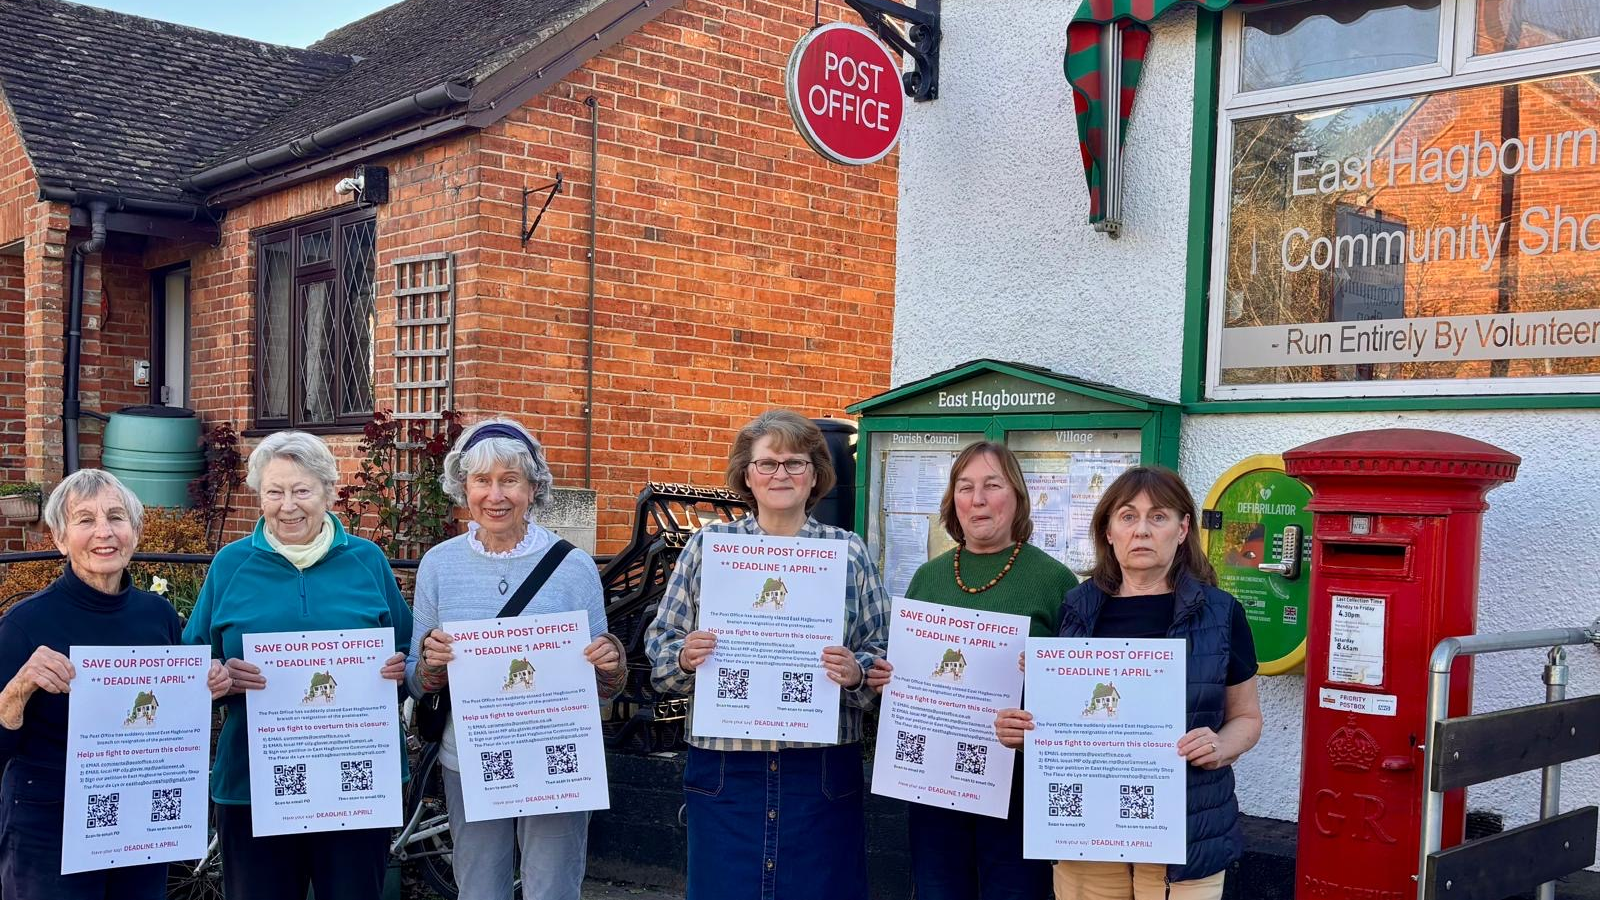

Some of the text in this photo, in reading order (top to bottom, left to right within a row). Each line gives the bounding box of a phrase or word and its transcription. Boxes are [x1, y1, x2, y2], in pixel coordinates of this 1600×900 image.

[825, 51, 884, 94] POST
[808, 84, 890, 132] OFFICE
[1293, 127, 1599, 196] East Hagbourn
[1282, 213, 1506, 272] Community
[1286, 328, 1332, 355] Run
[1340, 321, 1427, 358] Entirely
[1435, 320, 1467, 356] By
[1475, 317, 1600, 347] Volunteer
[938, 389, 1056, 411] East Hagbourne
[892, 433, 960, 444] Parish Council
[1055, 432, 1094, 445] Village
[1237, 502, 1296, 516] DEFIBRILLATOR
[713, 544, 836, 559] SAVE OUR POST OFFICE!
[732, 561, 816, 573] DEADLINE 1 APRIL
[1338, 610, 1361, 619] 4.30pm
[900, 609, 1018, 635] SAVE OUR POST OFFICE!
[454, 622, 578, 641] SAVE OUR POST OFFICE!
[708, 627, 724, 635] Help
[915, 629, 960, 643] DEADLINE
[969, 638, 996, 648] APRIL
[254, 639, 383, 652] SAVE OUR POST OFFICE!
[475, 644, 522, 655] DEADLINE
[532, 641, 560, 650] APRIL
[1036, 649, 1173, 660] SAVE OUR POST OFFICE!
[82, 657, 202, 668] SAVE OUR POST OFFICE!
[276, 658, 326, 667] DEADLINE
[336, 656, 364, 665] APRIL
[1058, 667, 1151, 676] DEADLINE 1 APRIL
[103, 676, 151, 685] DEADLINE
[160, 675, 185, 683] APRIL
[890, 690, 904, 698] Help
[914, 695, 929, 703] fight
[938, 700, 966, 708] overturn
[1340, 694, 1366, 703] PRIORITY
[1340, 702, 1366, 710] POSTBOX
[1064, 739, 1081, 747] fight
[525, 794, 555, 802] DEADLINE
[928, 786, 956, 796] DEADLINE
[961, 792, 980, 800] APRIL!
[316, 810, 347, 818] DEADLINE
[124, 842, 154, 851] DEADLINE
[159, 840, 178, 848] APRIL!
